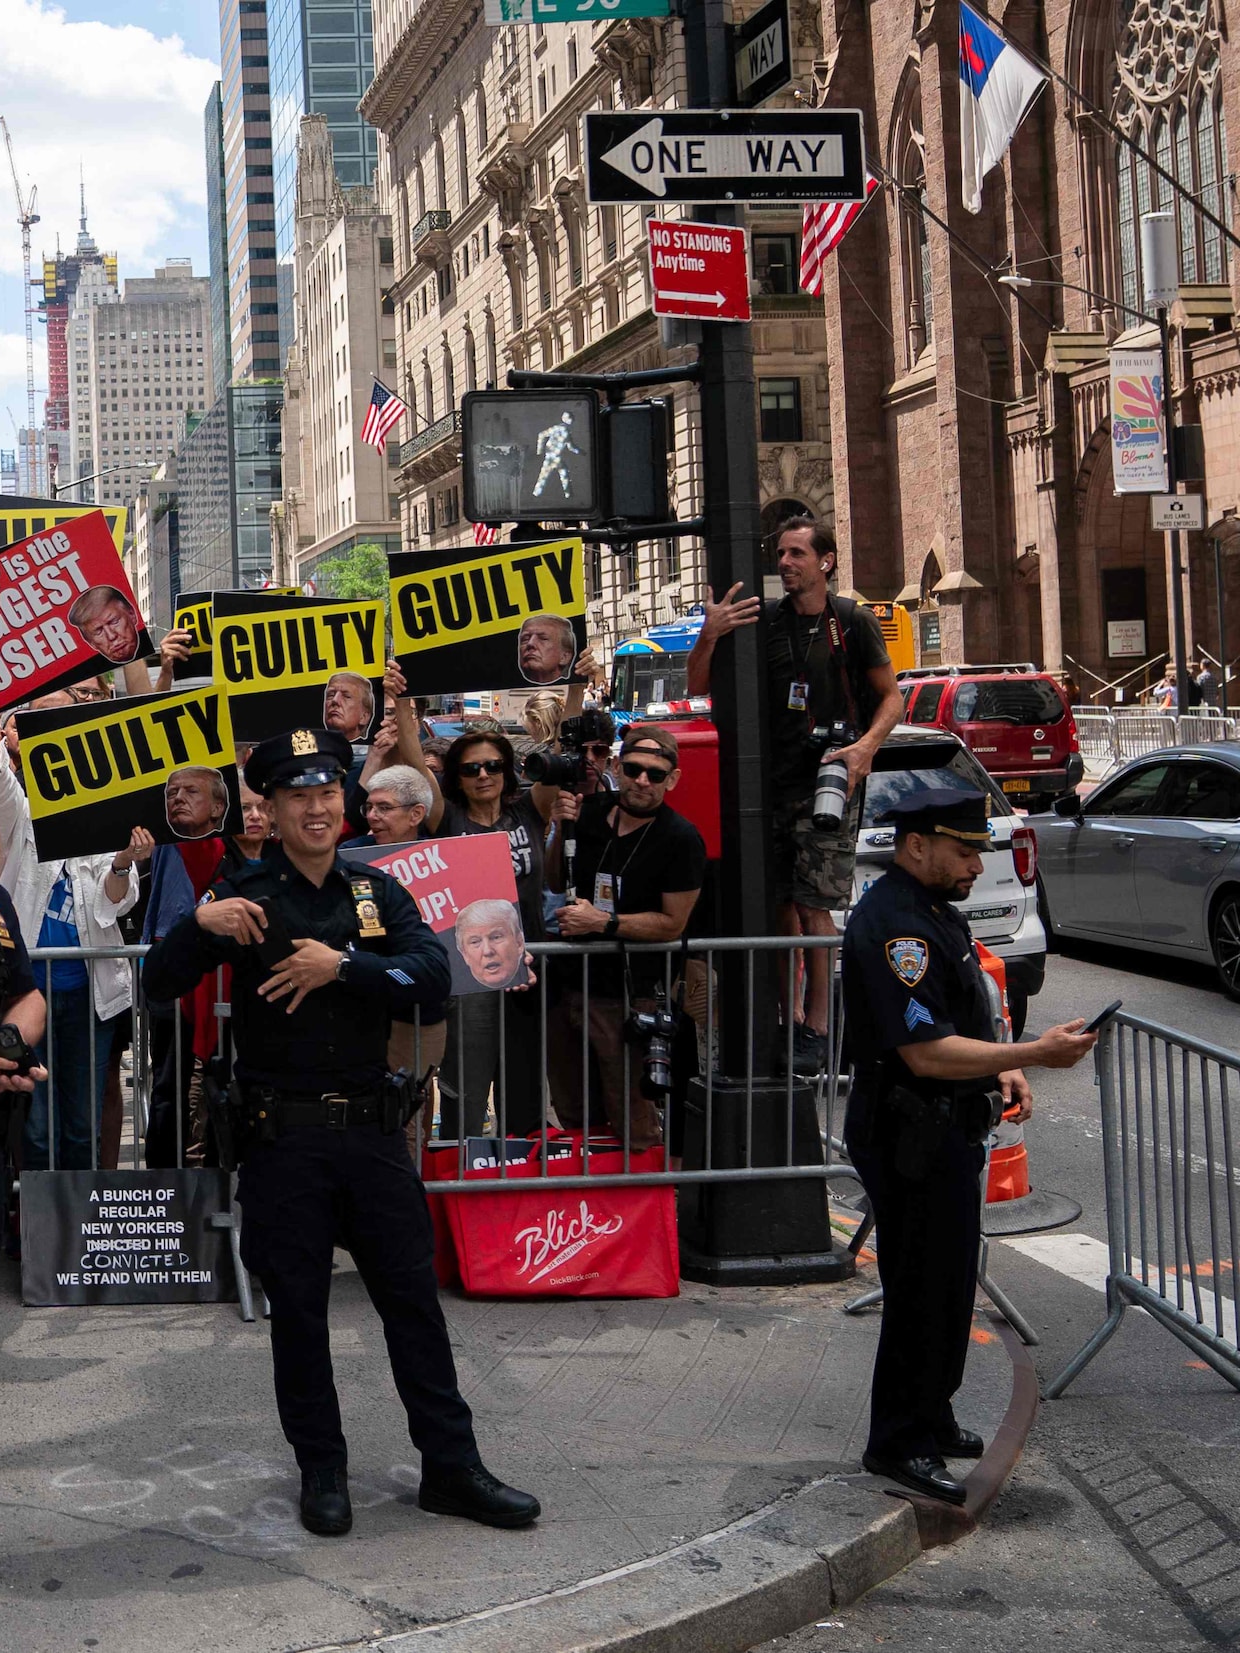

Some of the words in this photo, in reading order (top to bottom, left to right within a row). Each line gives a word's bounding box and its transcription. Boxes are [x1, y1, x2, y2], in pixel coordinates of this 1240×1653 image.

[748, 28, 777, 79] WAY
[631, 140, 707, 174] ONE
[746, 139, 827, 173] WAY
[653, 229, 671, 247] NO
[673, 231, 732, 253] STANDING
[656, 251, 706, 273] Anytime
[1, 553, 31, 581] is
[26, 531, 71, 566] the
[397, 547, 575, 640] GUILTY
[219, 608, 377, 683] GUILTY
[28, 693, 224, 802] GUILTY
[983, 908, 1003, 917] CARES
[89, 1190, 100, 1202] A
[103, 1189, 152, 1202] BUNCH
[155, 1188, 175, 1201] OF
[99, 1206, 166, 1218] REGULAR
[81, 1223, 113, 1235] NEW
[117, 1222, 185, 1234] YORKERS
[514, 1200, 605, 1275] Blick
[155, 1238, 180, 1250] HIM
[80, 1253, 189, 1269] CONVICTED
[57, 1273, 79, 1285] WE
[82, 1272, 130, 1284] STAND
[133, 1272, 168, 1284] WITH
[172, 1271, 211, 1283] THEM
[549, 1271, 600, 1286] DickBlick.com
